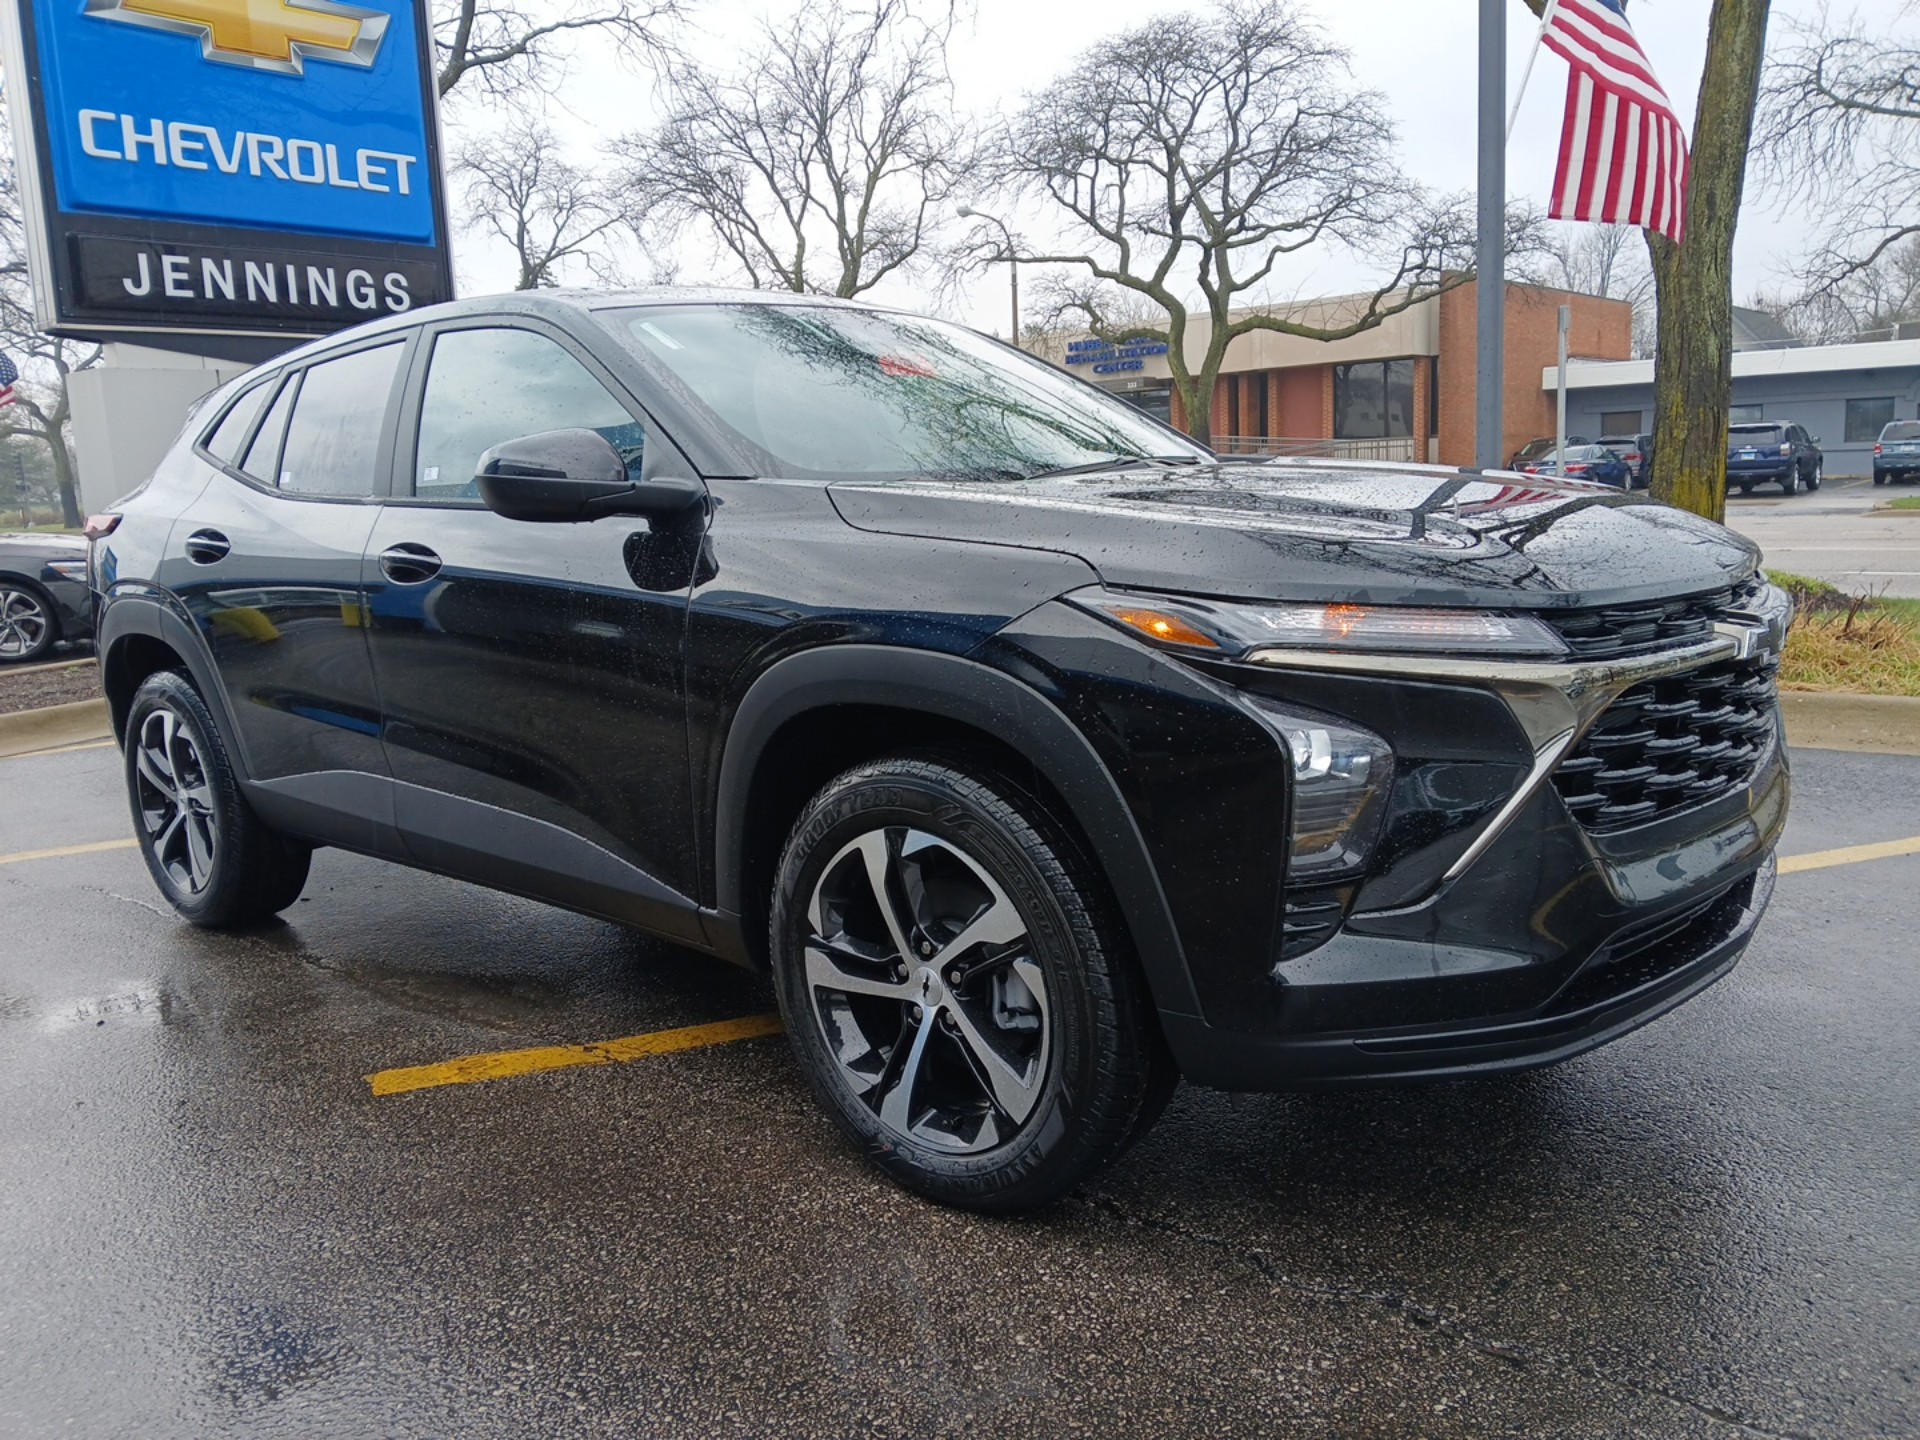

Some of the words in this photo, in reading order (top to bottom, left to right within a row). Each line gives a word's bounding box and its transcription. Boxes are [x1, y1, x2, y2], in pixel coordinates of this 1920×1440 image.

[79, 109, 416, 194] CHEVROLET
[122, 252, 411, 312] JENNINGS
[1093, 359, 1145, 374] CENTER
